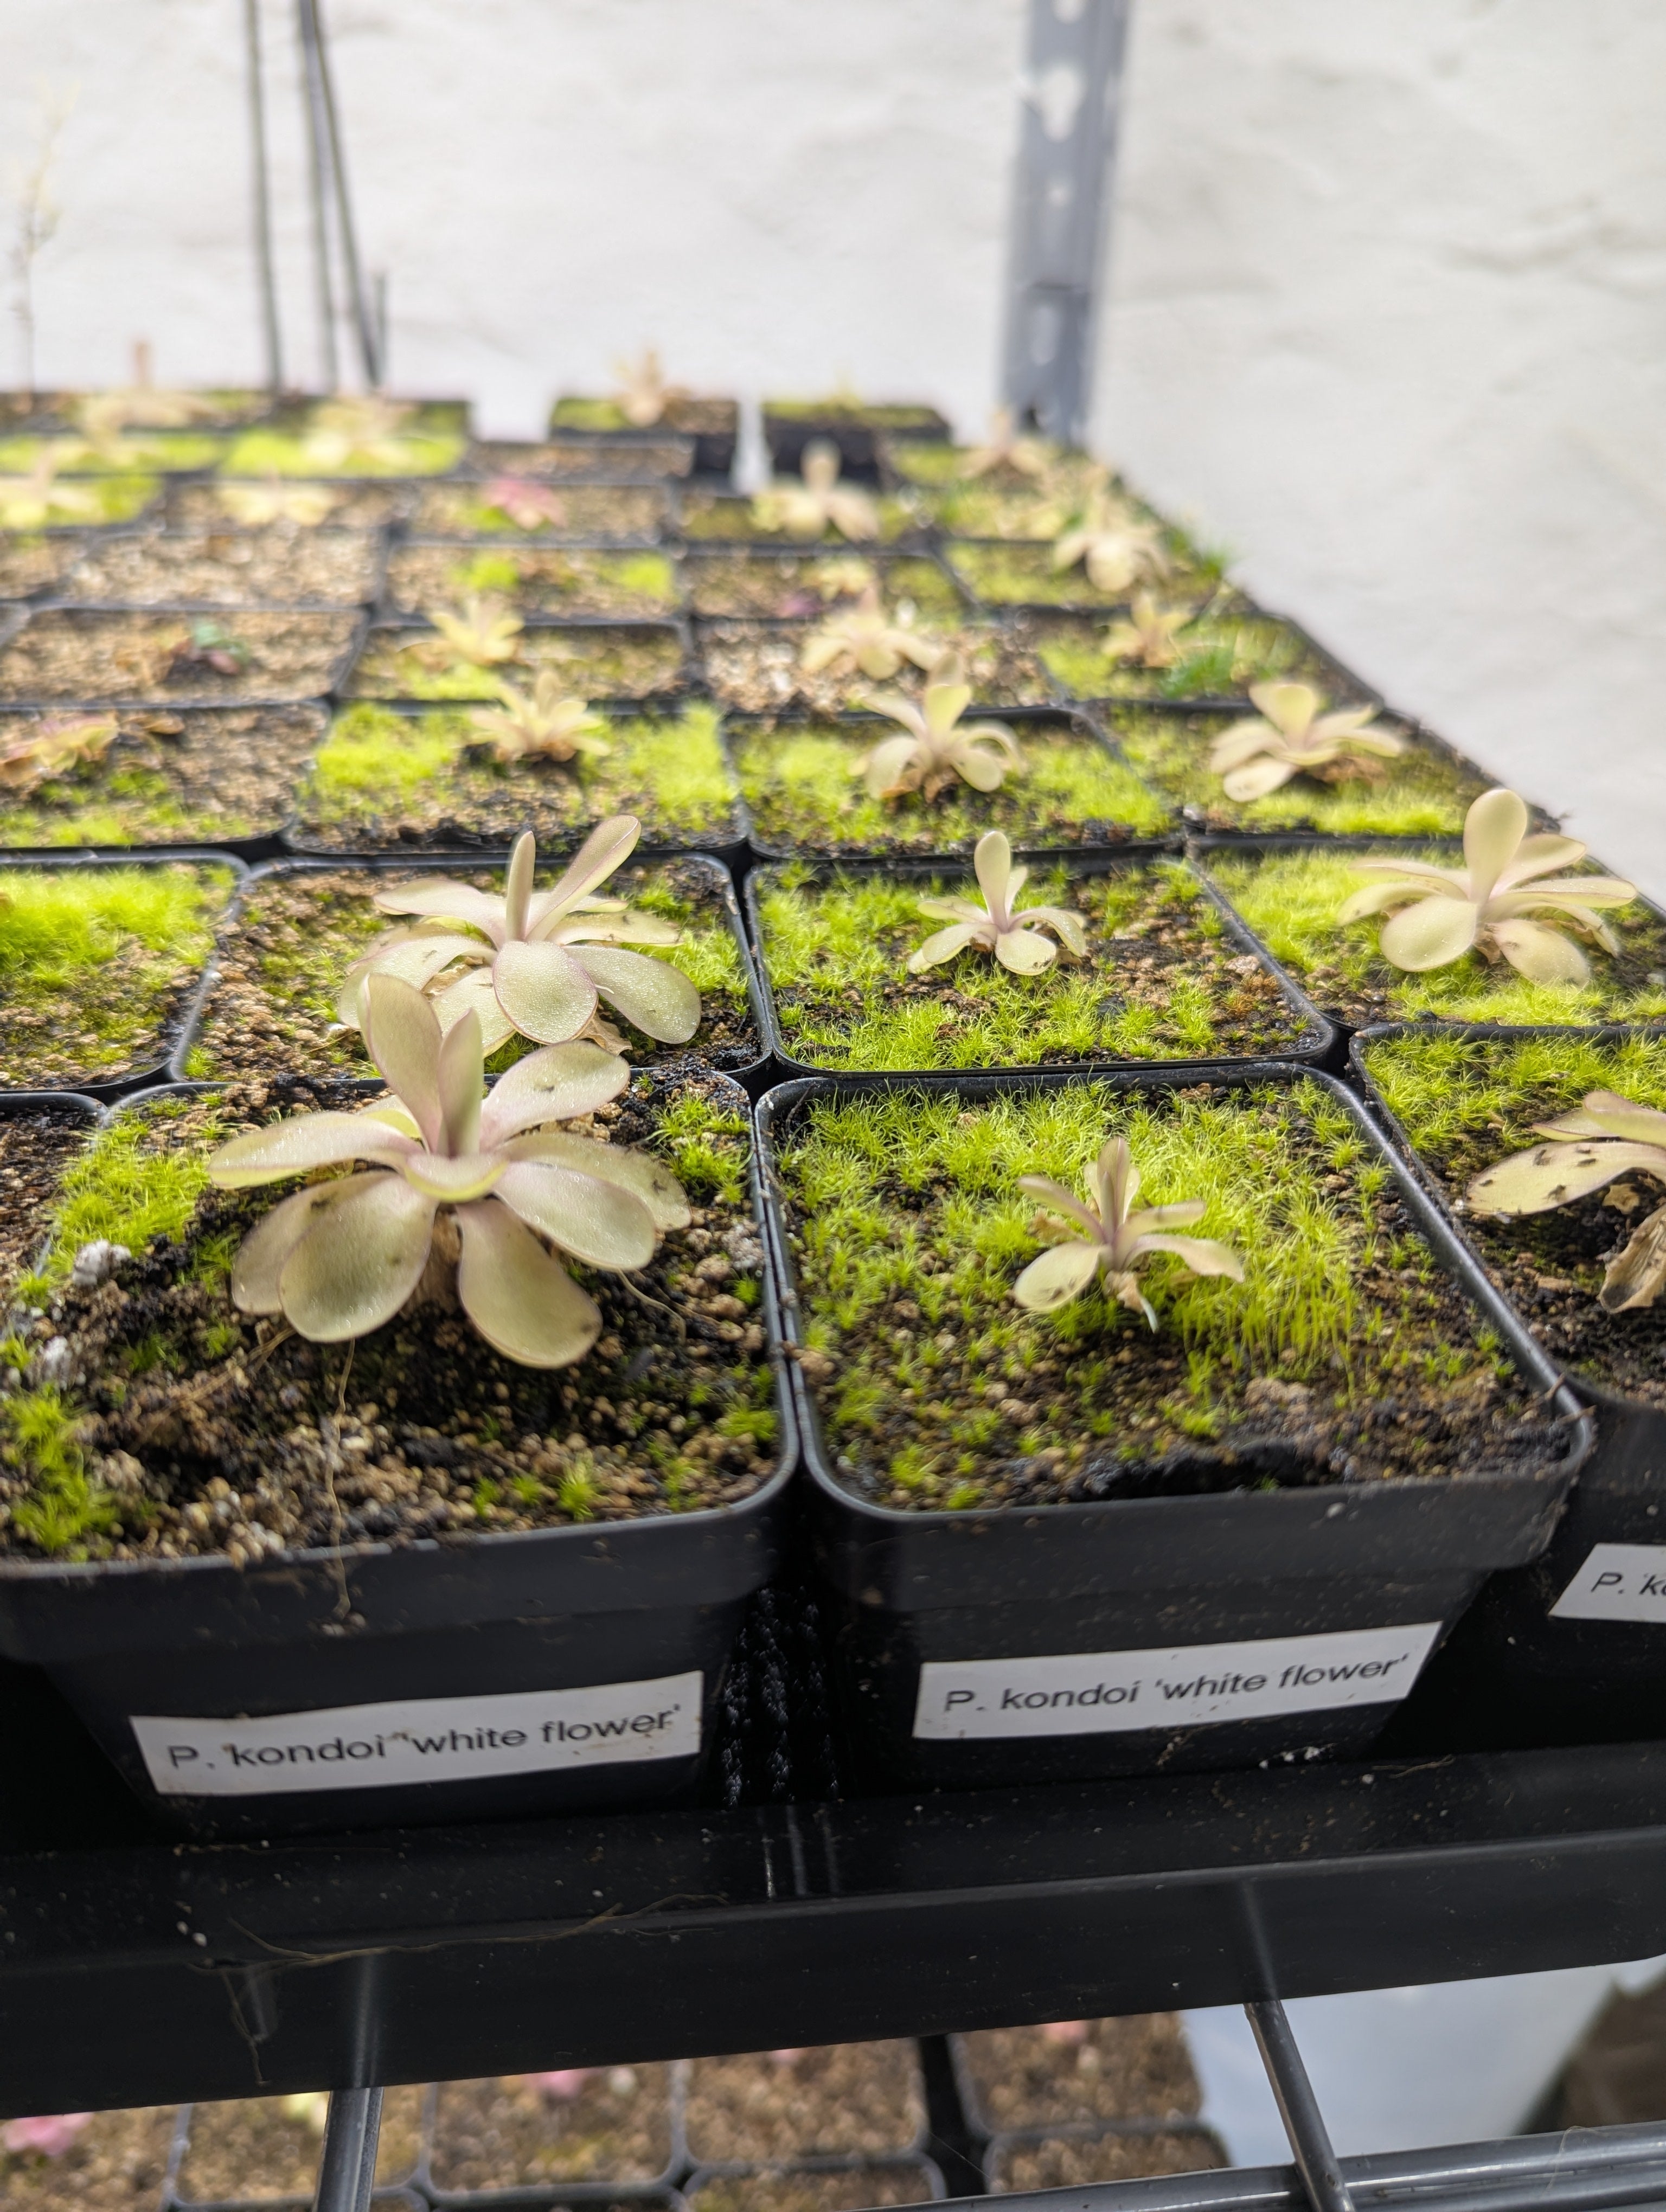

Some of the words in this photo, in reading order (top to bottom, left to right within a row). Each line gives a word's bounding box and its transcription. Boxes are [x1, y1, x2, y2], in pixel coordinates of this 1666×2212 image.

[1590, 1572, 1625, 1593] P.
[944, 1689, 985, 1712] P.
[1000, 1680, 1142, 1711] kondoi
[1155, 1672, 1267, 1700] 'white
[1277, 1652, 1409, 1689] flower'
[167, 1745, 215, 1770] P.
[229, 1734, 387, 1766] kondoi
